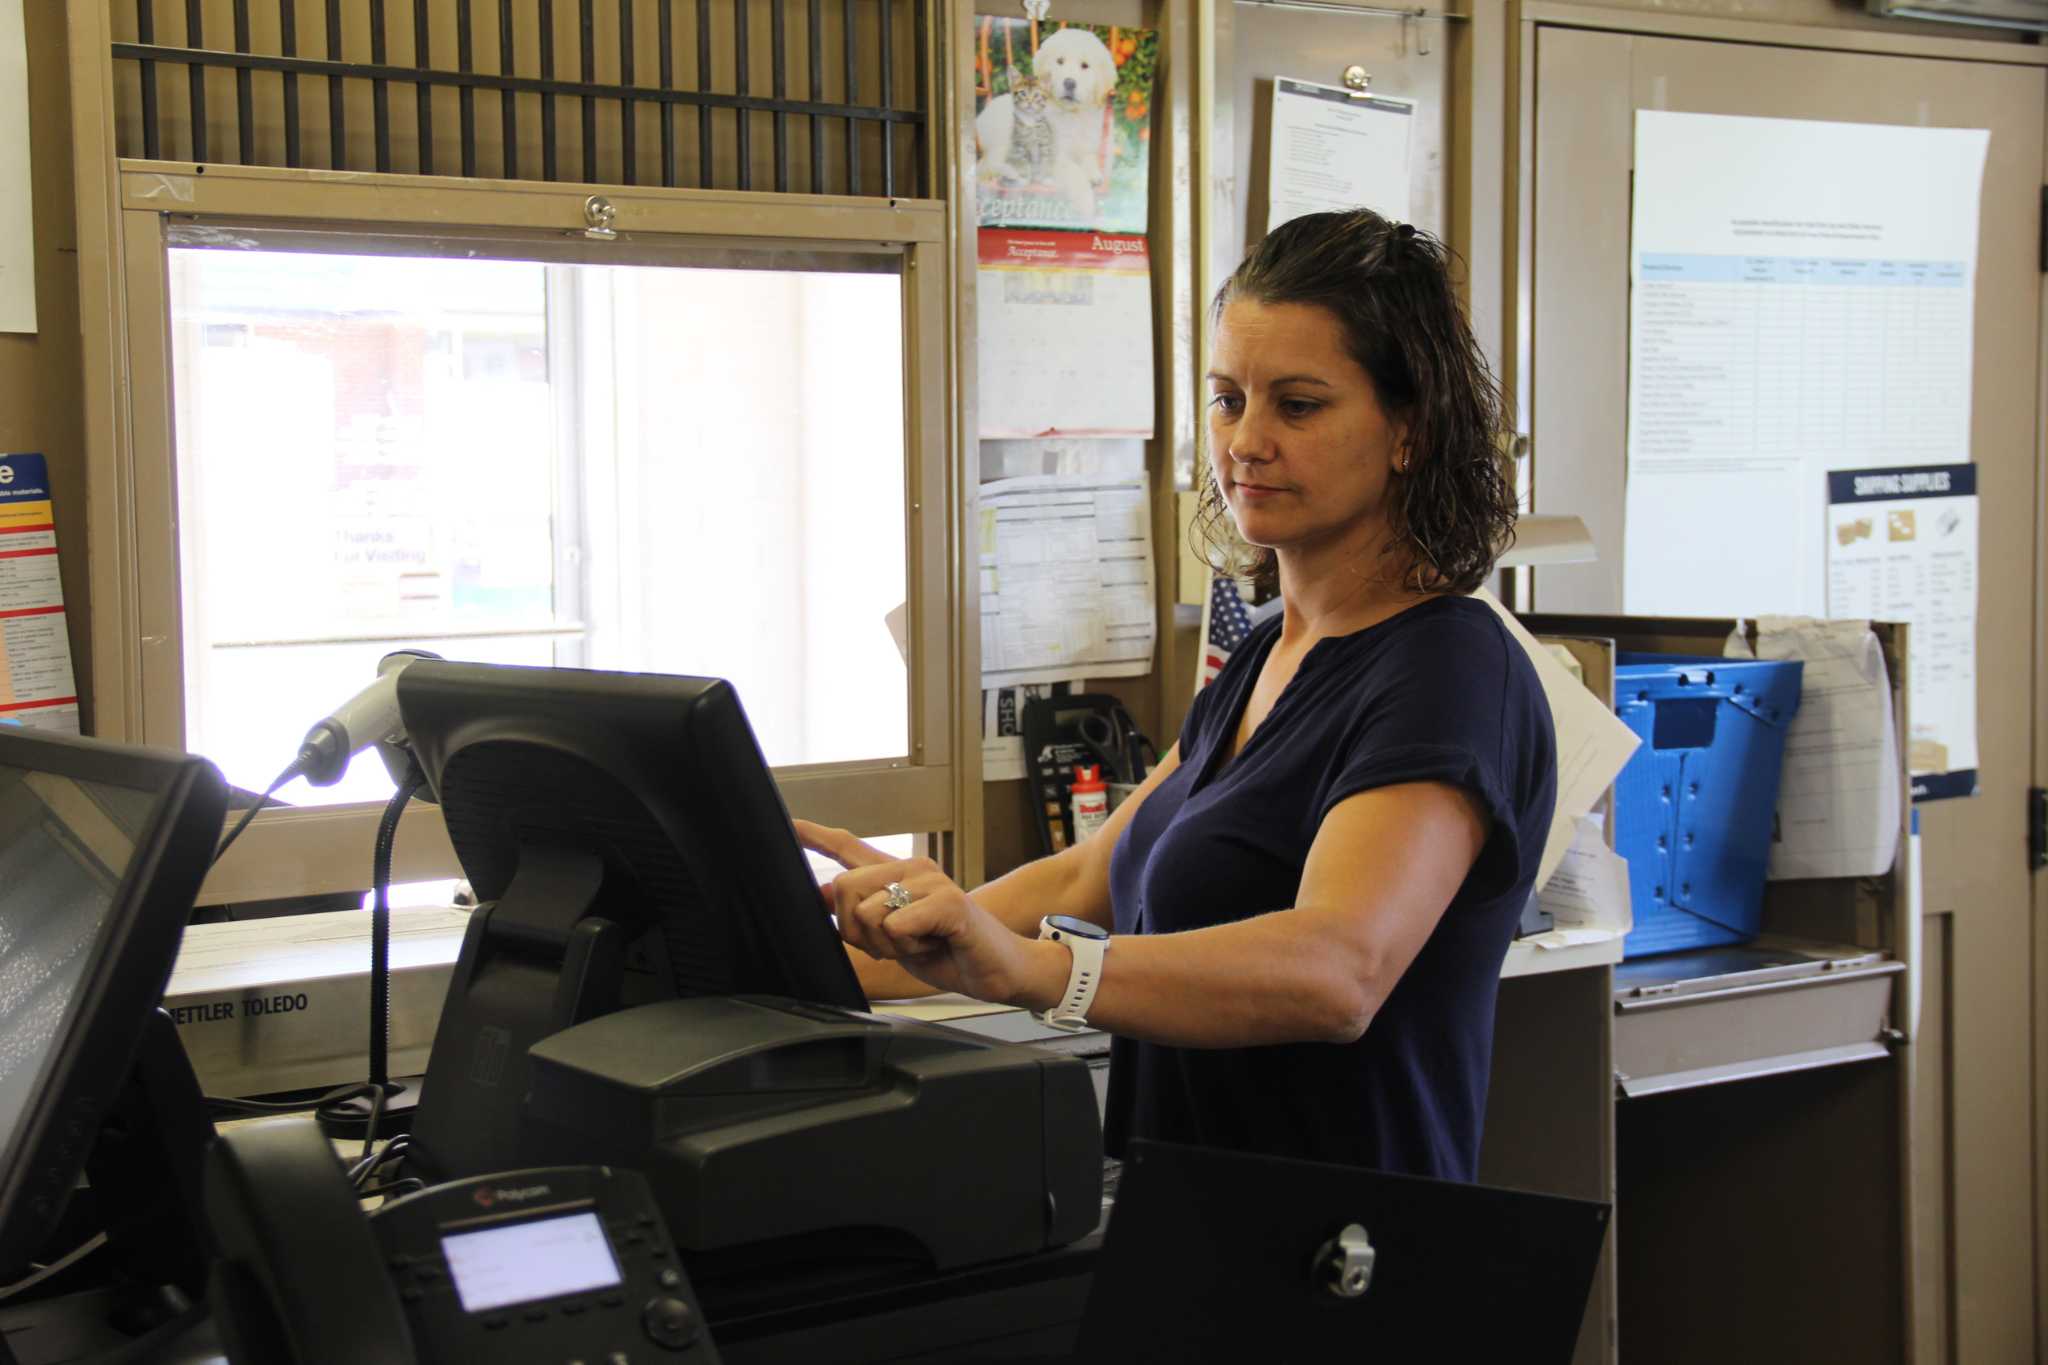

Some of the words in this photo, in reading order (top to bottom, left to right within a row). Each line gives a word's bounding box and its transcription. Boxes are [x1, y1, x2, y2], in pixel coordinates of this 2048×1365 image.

[1091, 235, 1144, 255] August
[1854, 473, 1900, 496] SHIPPING
[1900, 471, 1951, 493] SUPPLIES
[241, 993, 308, 1017] TOLEDO
[496, 1184, 551, 1202] Polycom
